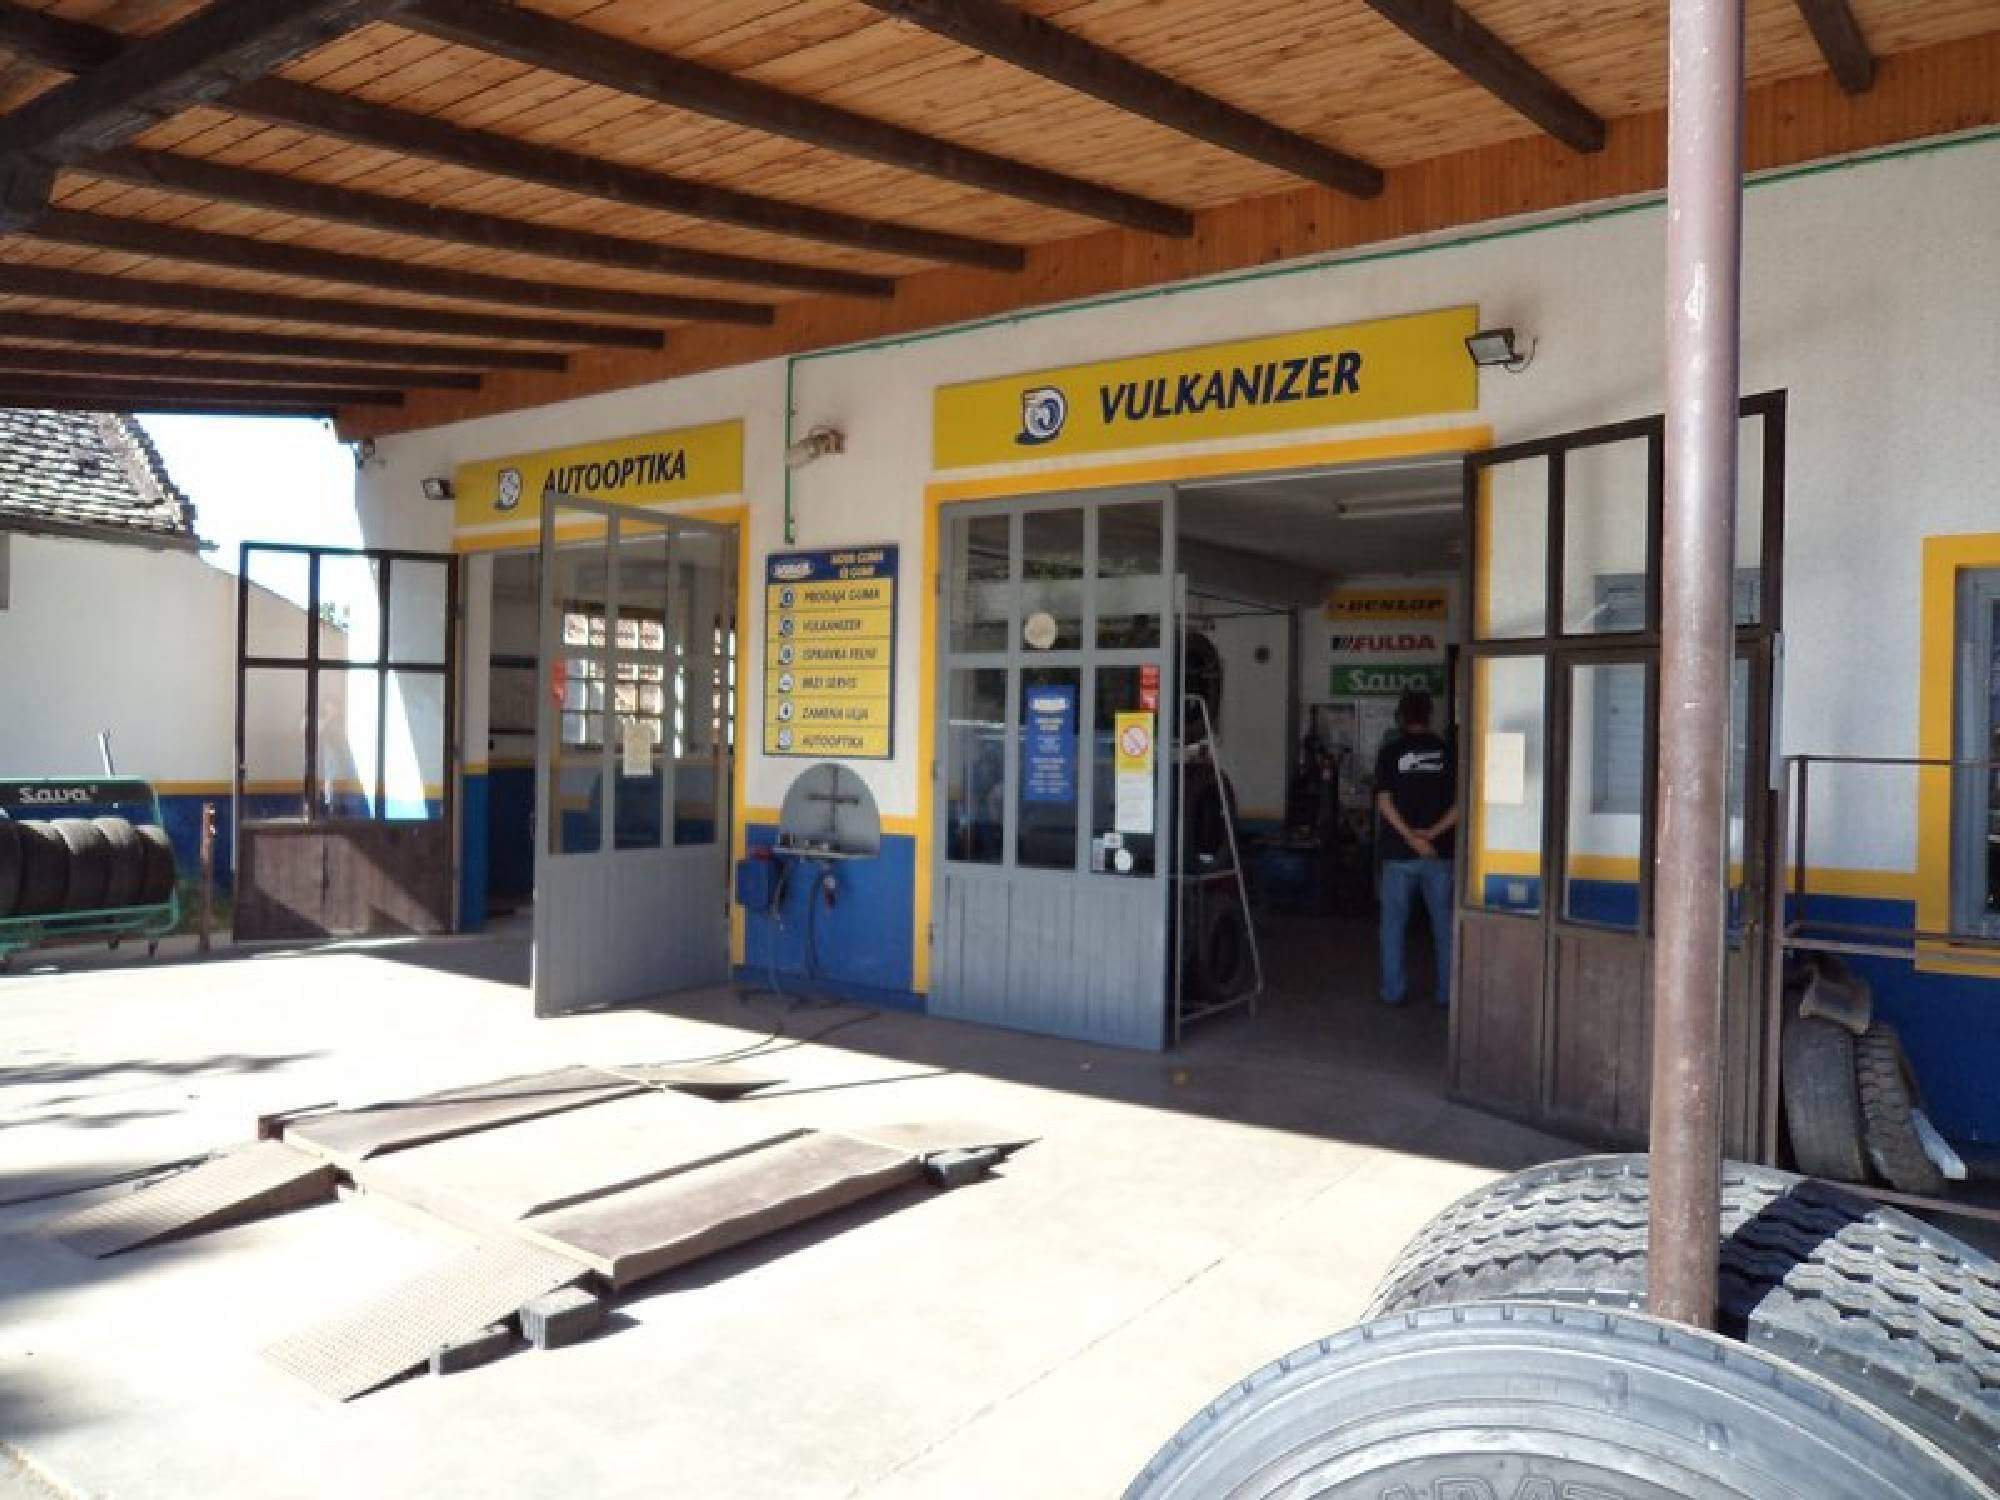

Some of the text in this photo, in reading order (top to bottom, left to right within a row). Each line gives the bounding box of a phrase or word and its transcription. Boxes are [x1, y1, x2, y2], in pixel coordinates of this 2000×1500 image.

[1099, 351, 1362, 424] VULKANIZER
[543, 449, 686, 494] AUTOOPTIKA
[803, 619, 860, 631] VULKANIZER
[1351, 634, 1437, 651] FULDA
